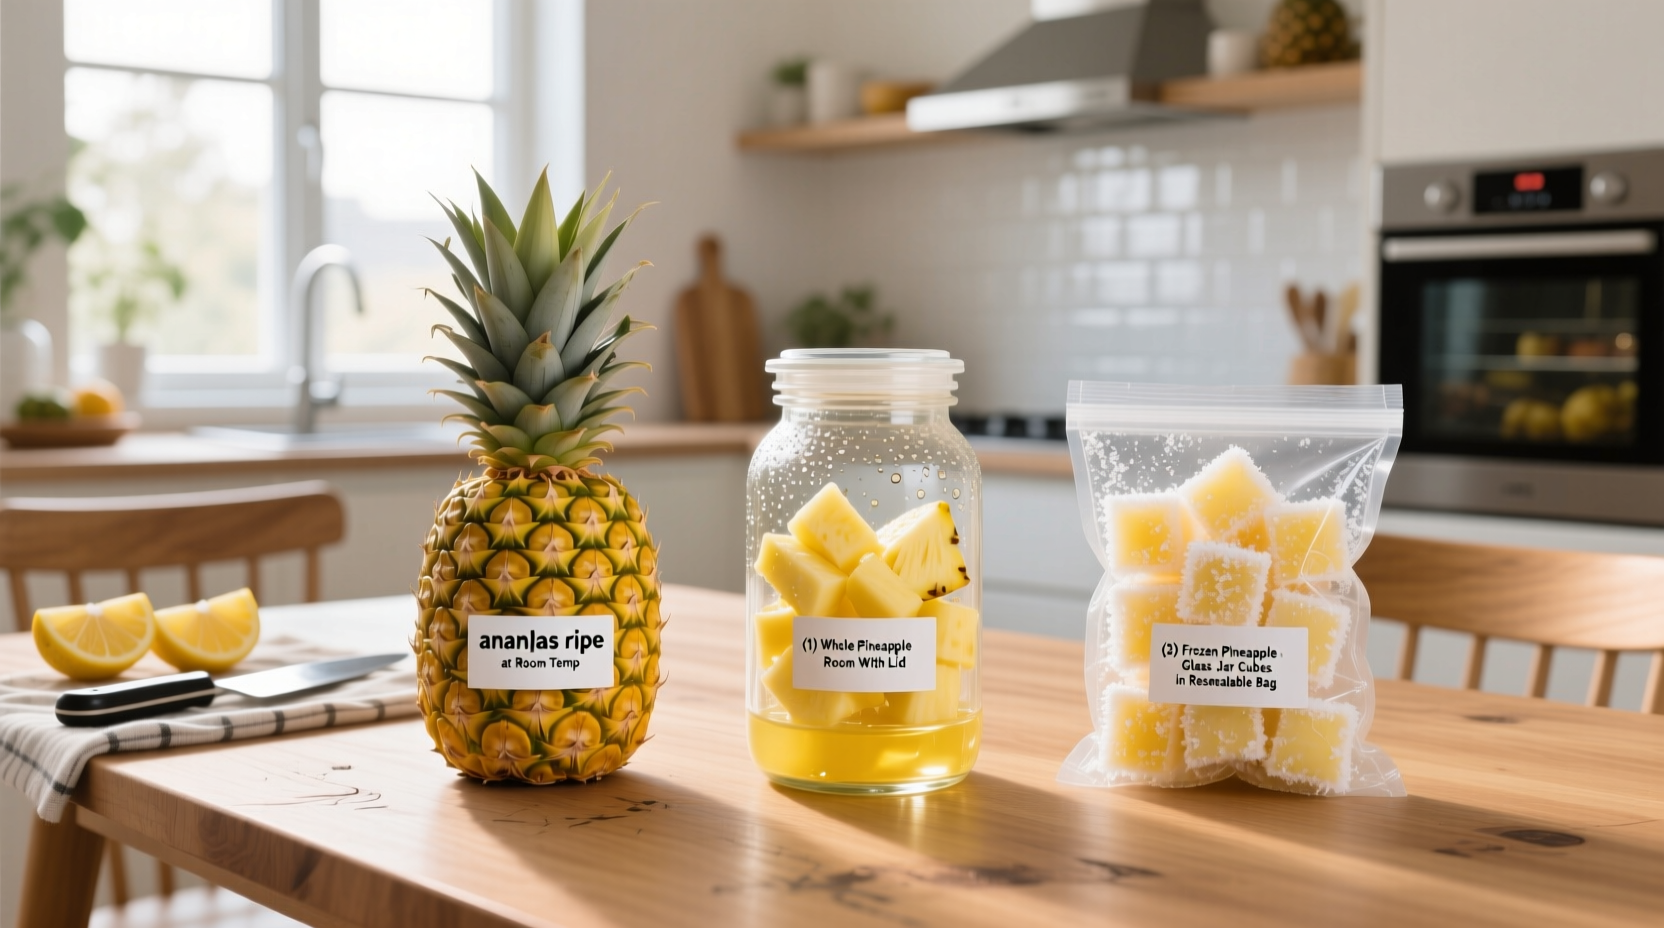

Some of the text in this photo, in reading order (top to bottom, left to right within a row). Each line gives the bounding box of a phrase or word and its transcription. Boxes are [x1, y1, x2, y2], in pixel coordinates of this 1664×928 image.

[565, 629, 604, 654] ripe
[802, 637, 818, 654] (1)
[1161, 641, 1178, 658] (2)
[501, 657, 580, 671] at Room Temp
[823, 656, 855, 668] Room
[1256, 676, 1277, 691] Bag
